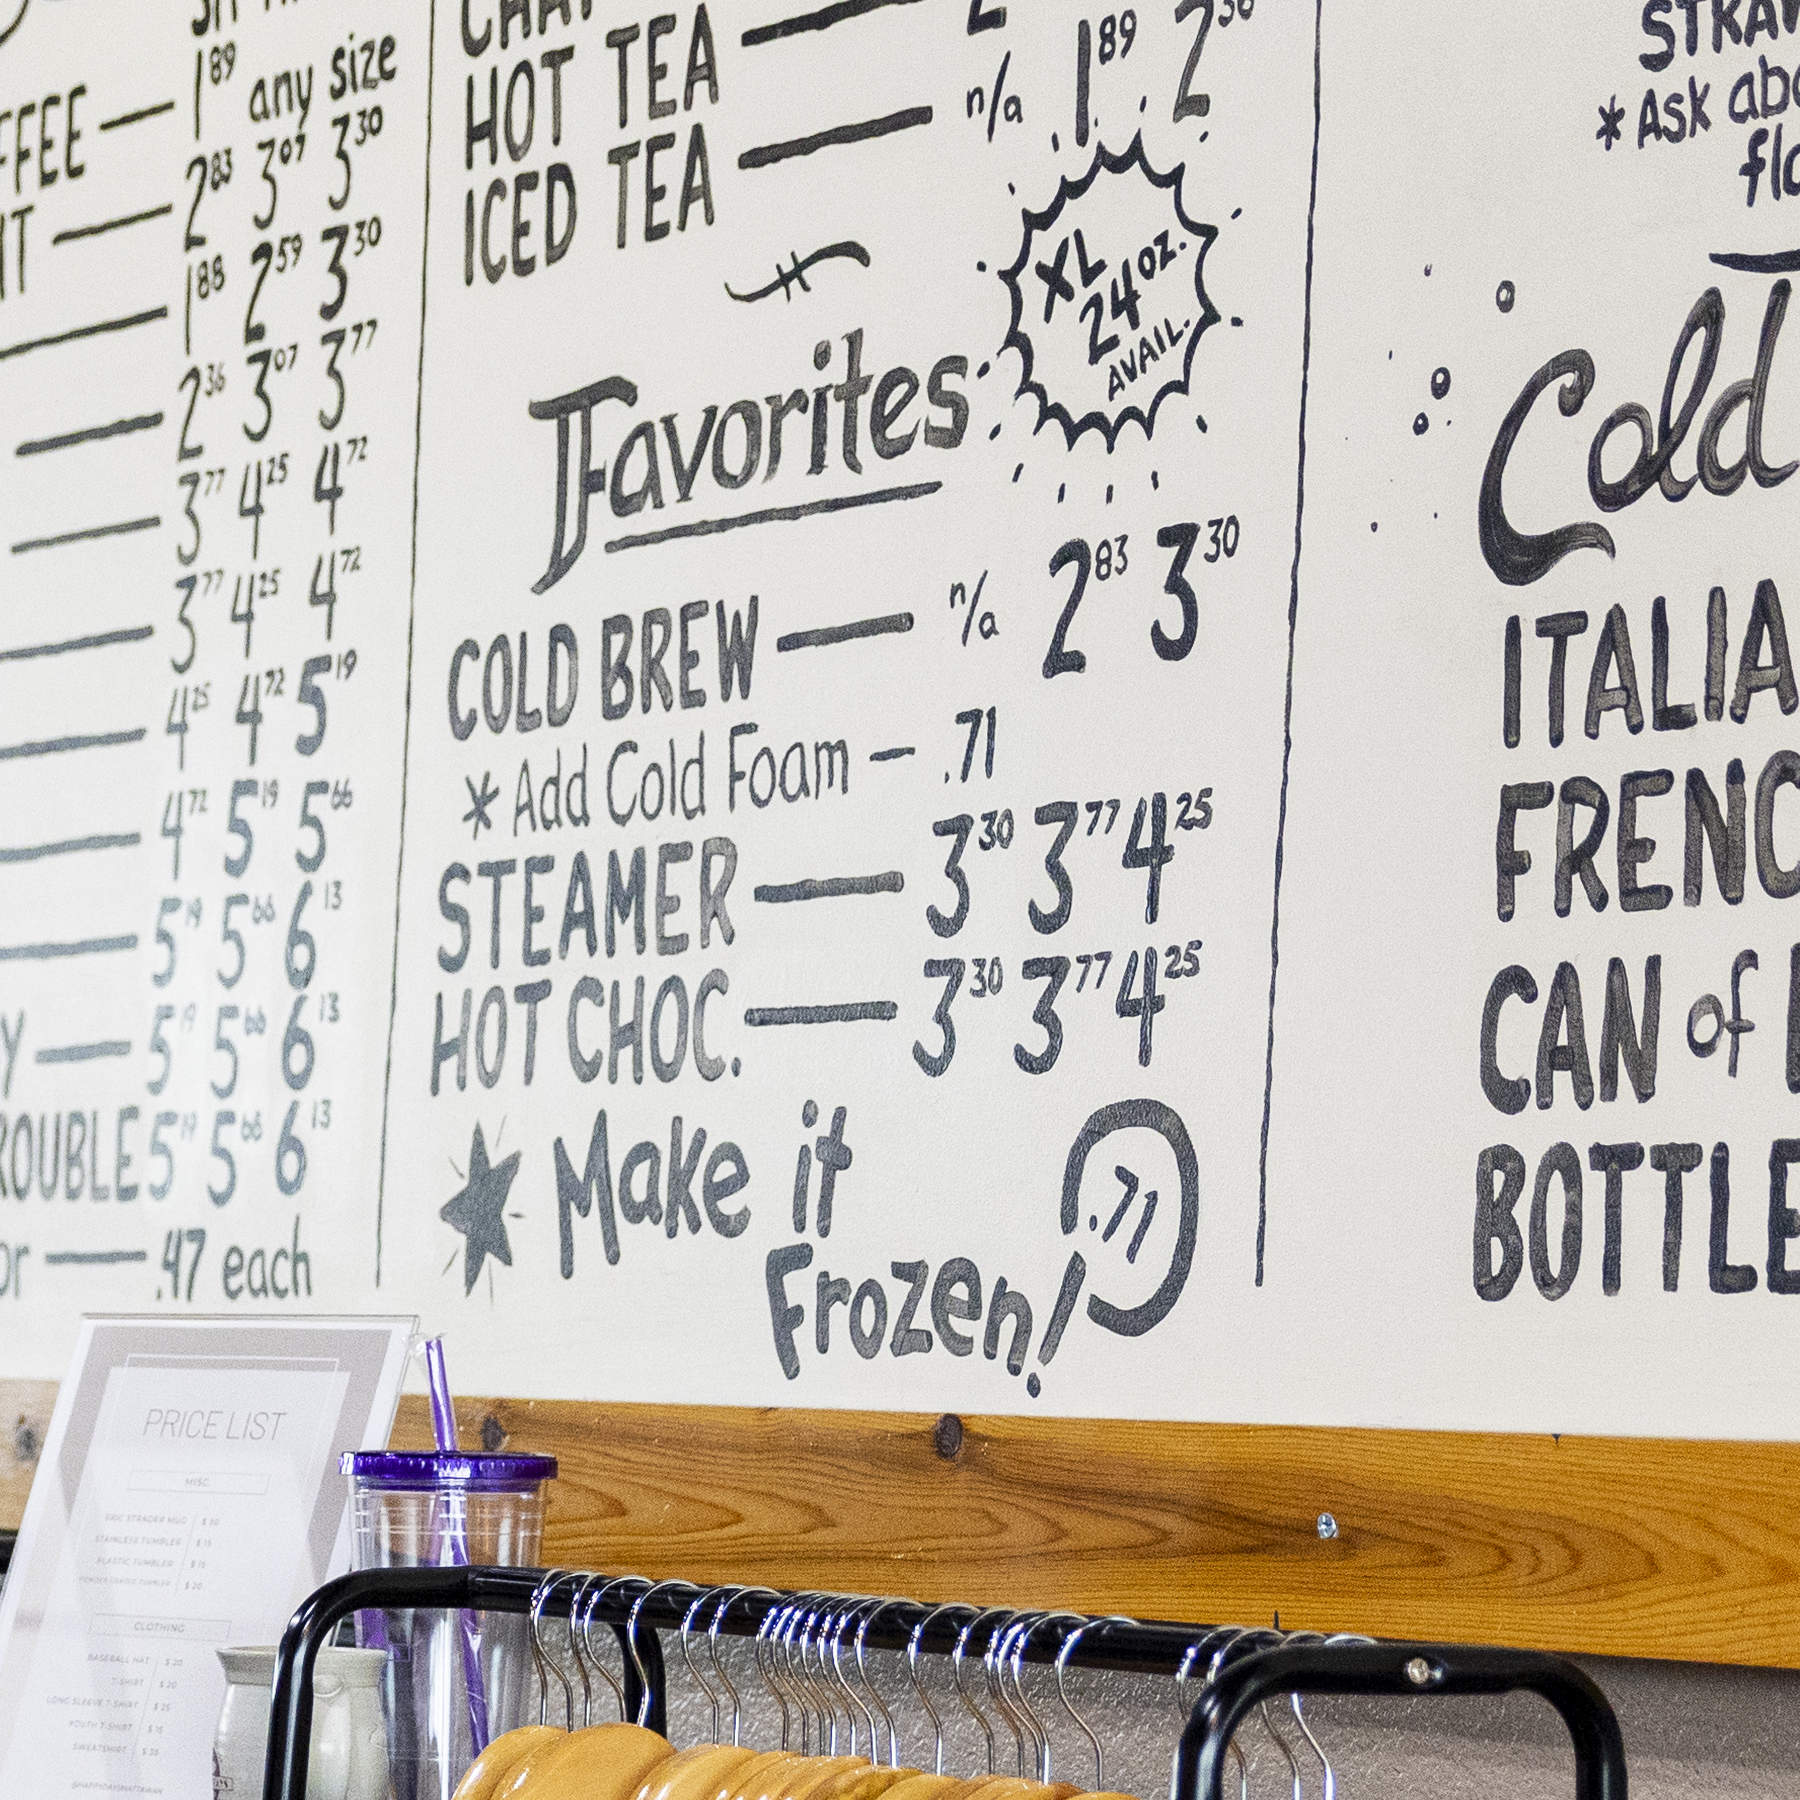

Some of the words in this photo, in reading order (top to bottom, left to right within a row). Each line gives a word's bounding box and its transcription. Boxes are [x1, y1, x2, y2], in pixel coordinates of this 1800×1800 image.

[250, 66, 313, 133] any
[329, 33, 397, 101] size
[465, 45, 575, 170] HOT
[606, 2, 719, 129] TEA
[464, 163, 577, 287] ICED
[607, 123, 715, 250] TEA
[1035, 229, 1107, 324] XL
[1079, 259, 1141, 365] 24
[528, 328, 969, 595] Favorites
[1478, 278, 1800, 586] Cold
[447, 623, 578, 741] COLD
[601, 595, 759, 721] BREW
[1503, 578, 1800, 749] ITALIA
[606, 731, 706, 827] Cold
[729, 722, 849, 812] Foam
[437, 837, 738, 974] STEAMER
[430, 979, 552, 1097] HOT
[568, 968, 741, 1085] CHOC.
[1480, 954, 1661, 1115] CAN
[1687, 949, 1758, 1078] of
[223, 1215, 312, 1300] each
[554, 1109, 751, 1280] Make
[792, 1099, 853, 1238] it
[766, 1243, 1086, 1398] Frozen!
[143, 1408, 224, 1439] PRICE
[226, 1411, 288, 1441] LIST
[134, 1622, 185, 1633] CLOTHING
